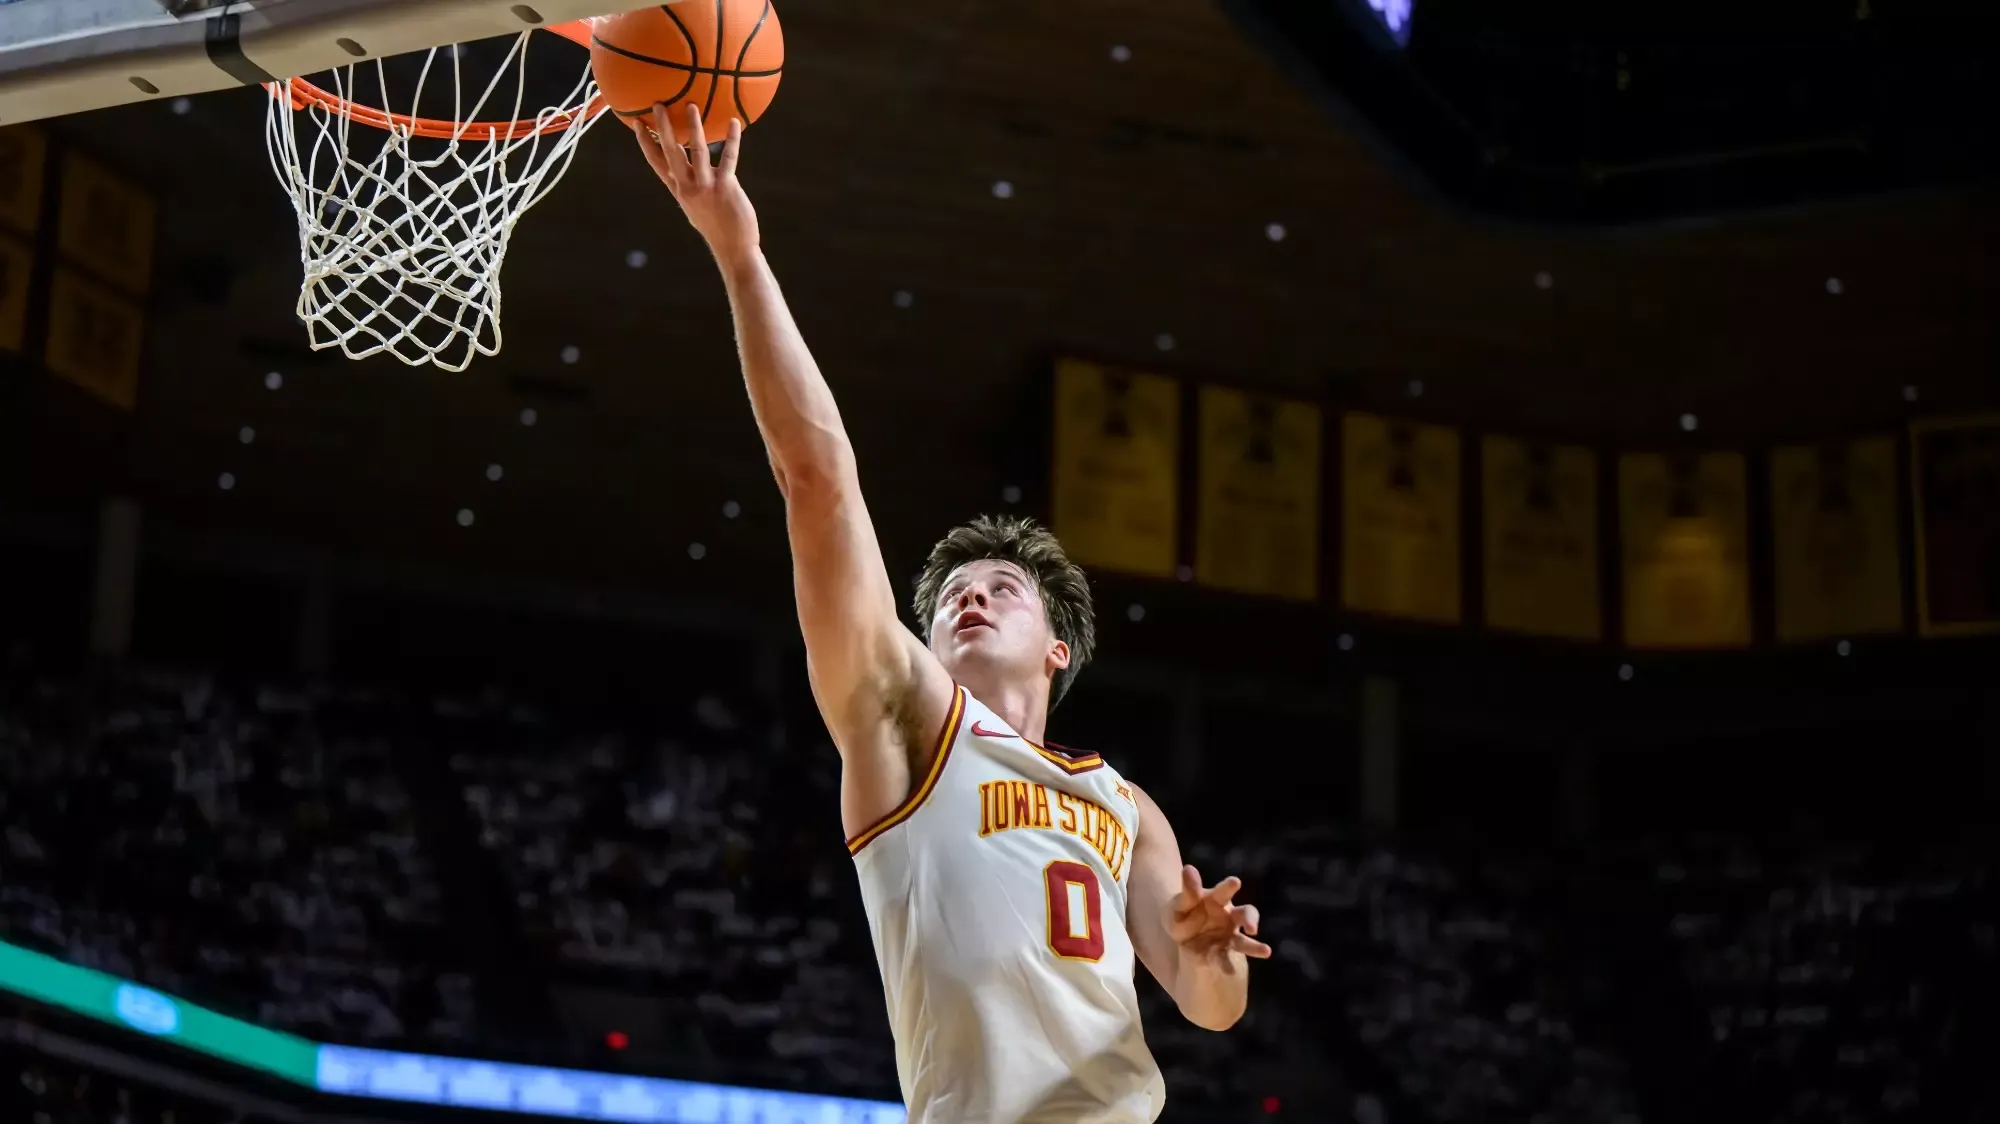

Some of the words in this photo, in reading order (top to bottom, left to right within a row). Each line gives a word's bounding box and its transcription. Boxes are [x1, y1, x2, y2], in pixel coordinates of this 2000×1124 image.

[979, 780, 1053, 838] IOWA
[1056, 789, 1130, 883] STATE
[1043, 860, 1105, 963] 0
